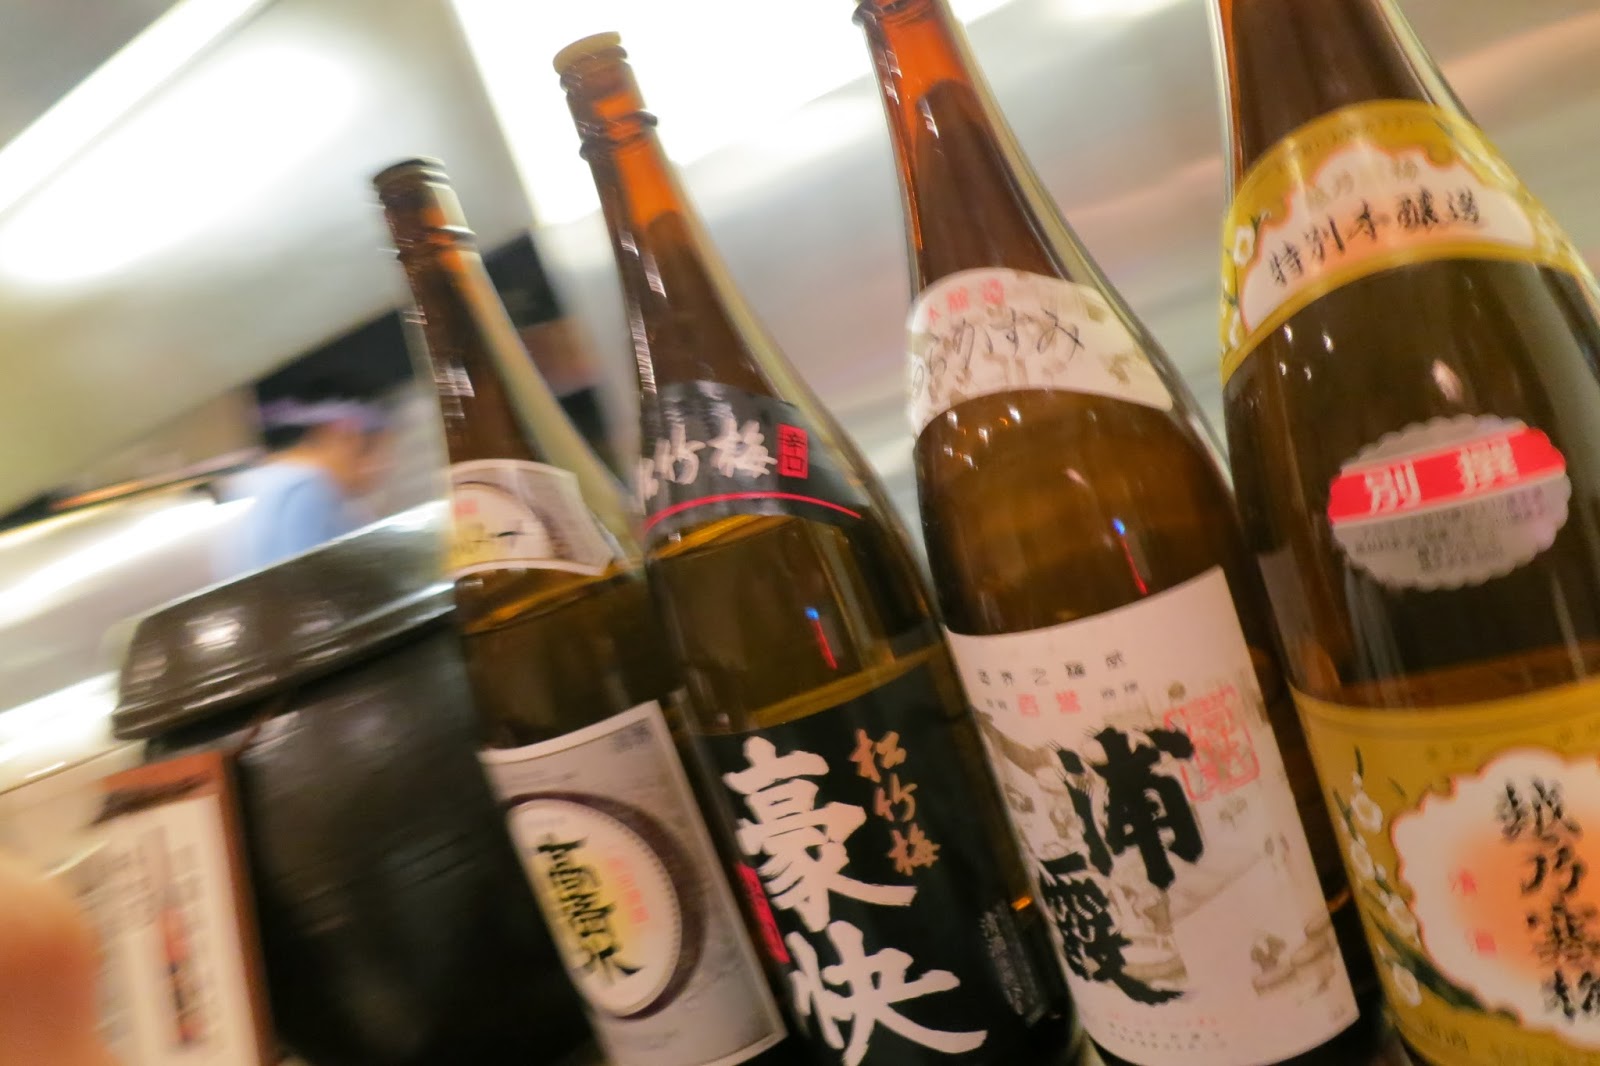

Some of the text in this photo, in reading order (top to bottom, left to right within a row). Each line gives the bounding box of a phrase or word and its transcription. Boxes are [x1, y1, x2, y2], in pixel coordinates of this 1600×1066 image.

[722, 735, 989, 1066] 豪快
[849, 728, 941, 877] 松竹梅
